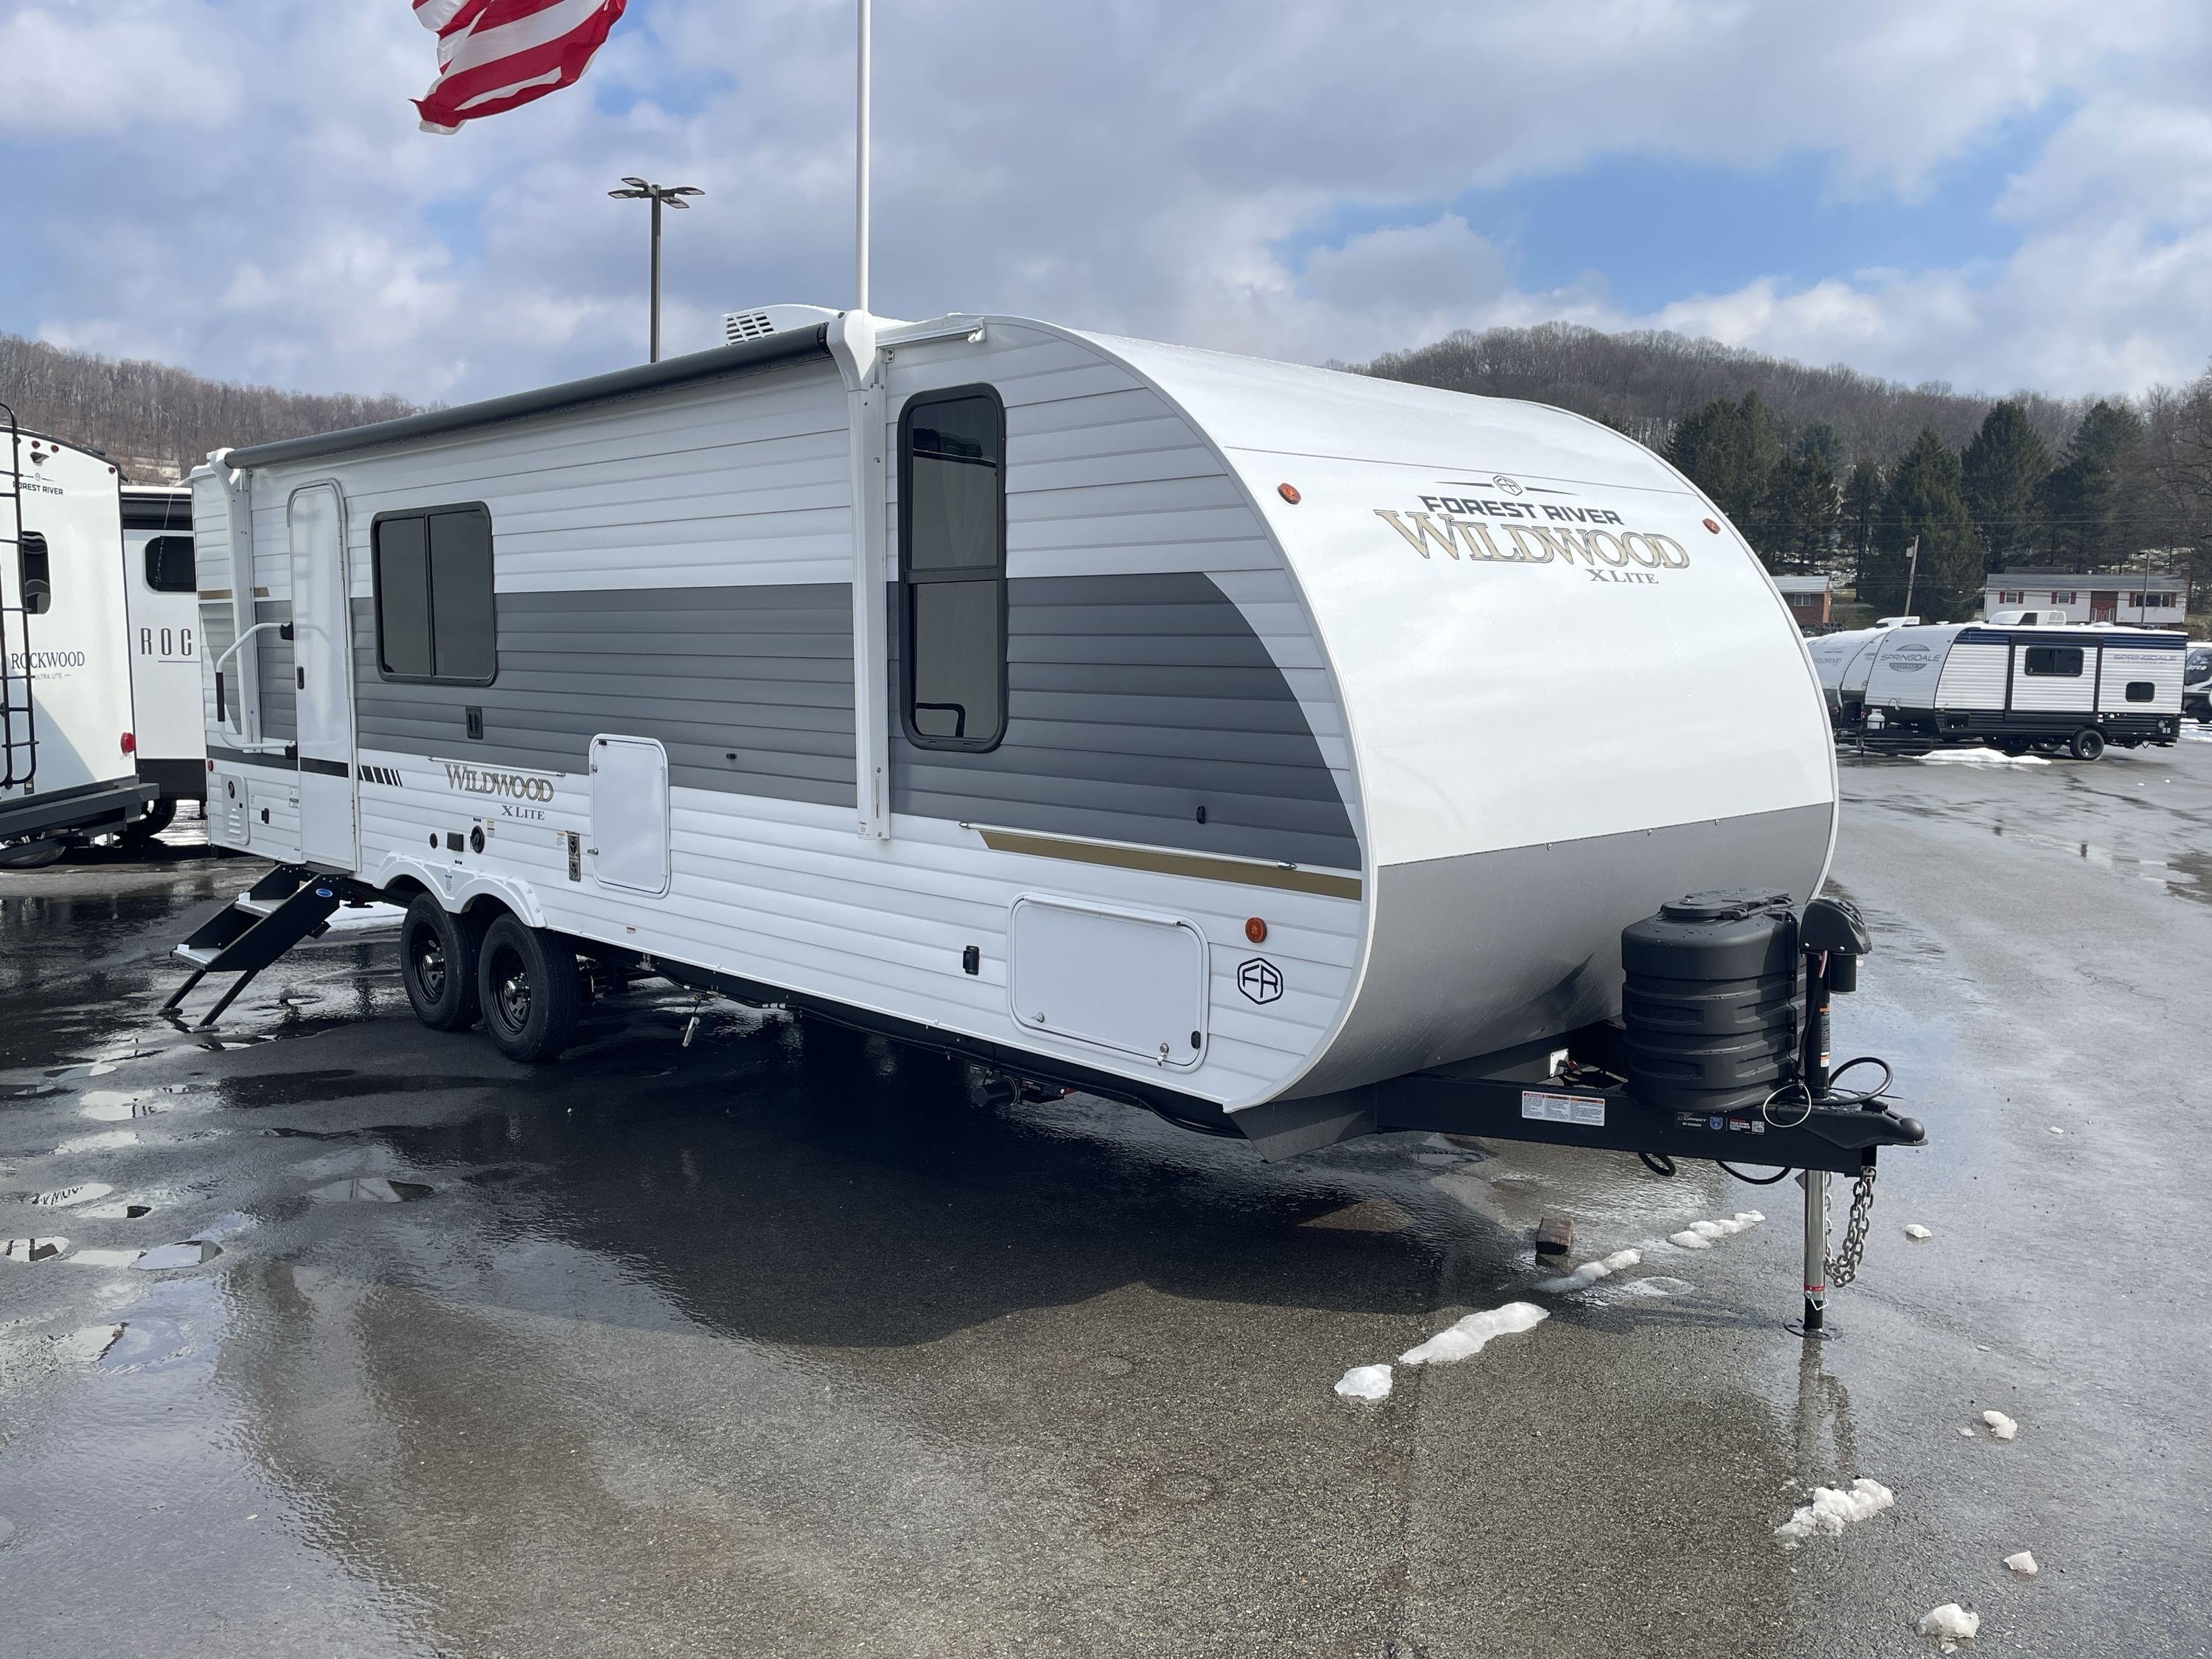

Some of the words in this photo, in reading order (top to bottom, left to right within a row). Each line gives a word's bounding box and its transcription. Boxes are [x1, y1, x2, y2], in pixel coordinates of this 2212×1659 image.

[42, 486, 63, 495] RIVER
[1417, 495, 1538, 519] FOREST
[1540, 504, 1626, 525] RIVER
[1373, 509, 1691, 569] WILDWOOD
[1585, 568, 1607, 582] X
[1608, 571, 1660, 585] LITE
[11, 651, 85, 669] ROCKWOOD
[1881, 654, 1941, 662] SPRINGDALE
[444, 763, 554, 802] WILDWOOD
[501, 804, 513, 817] X
[515, 807, 545, 821] LITE
